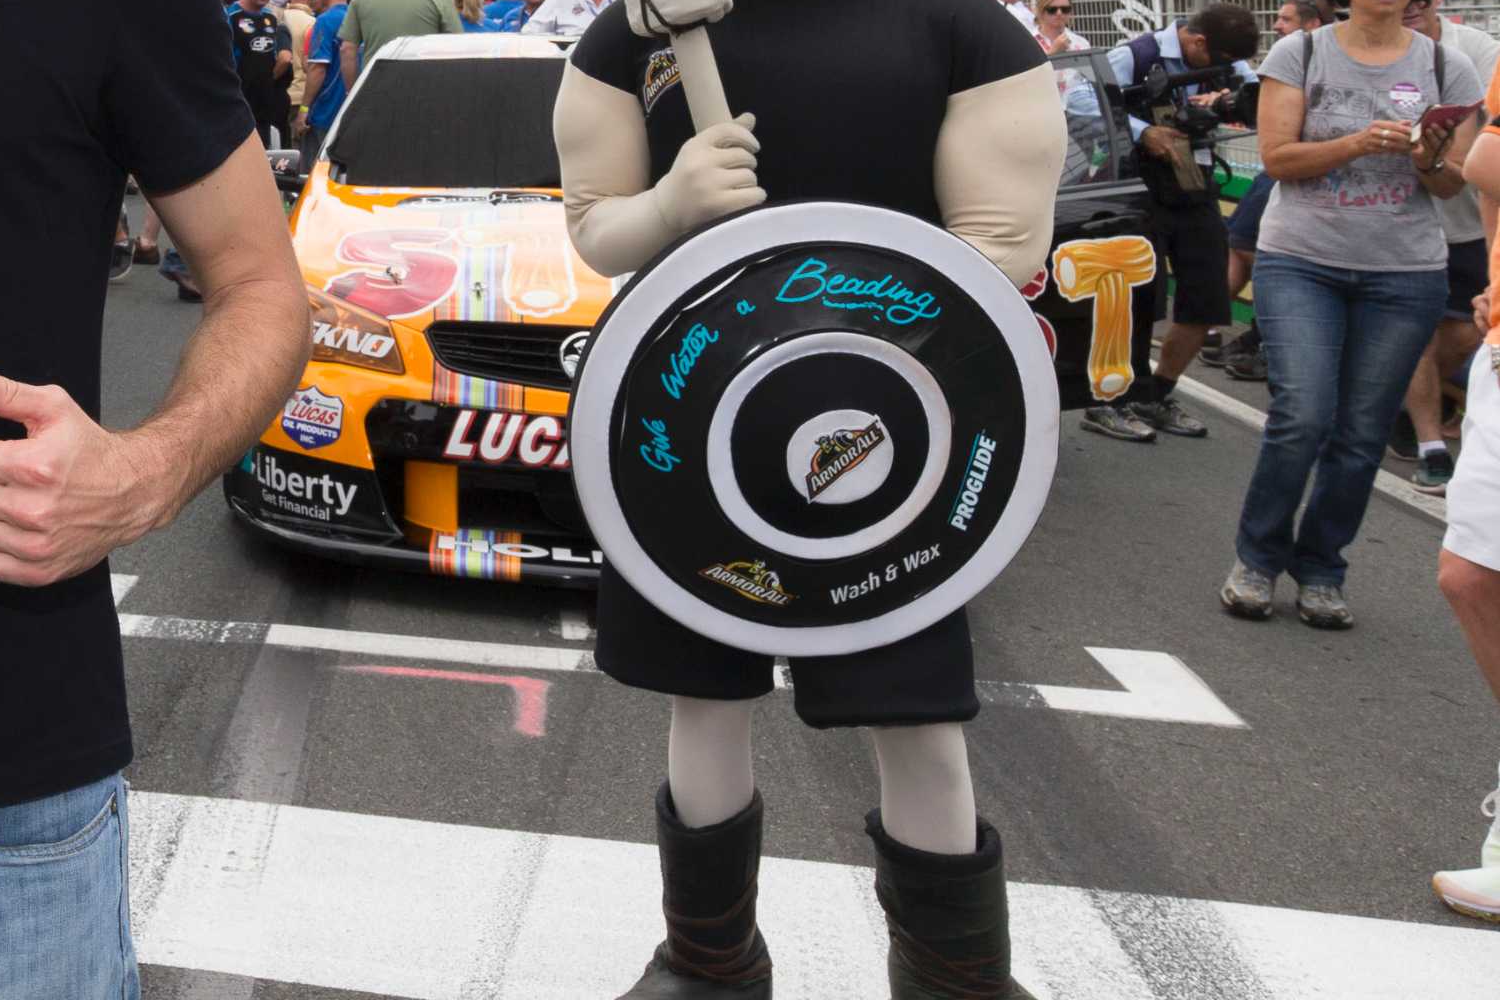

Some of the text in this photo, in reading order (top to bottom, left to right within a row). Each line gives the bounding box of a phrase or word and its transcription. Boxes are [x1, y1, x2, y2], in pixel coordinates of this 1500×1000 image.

[313, 321, 395, 358] KNO
[660, 323, 720, 399] Water
[775, 258, 941, 324] Beading
[291, 403, 338, 425] LUCAS
[443, 409, 571, 469] LUC
[256, 452, 358, 516] Liberty
[279, 495, 330, 521] Financial
[951, 434, 997, 531] PROGLIDE
[438, 535, 603, 564] HOL
[830, 543, 941, 605] Wash & Wax
